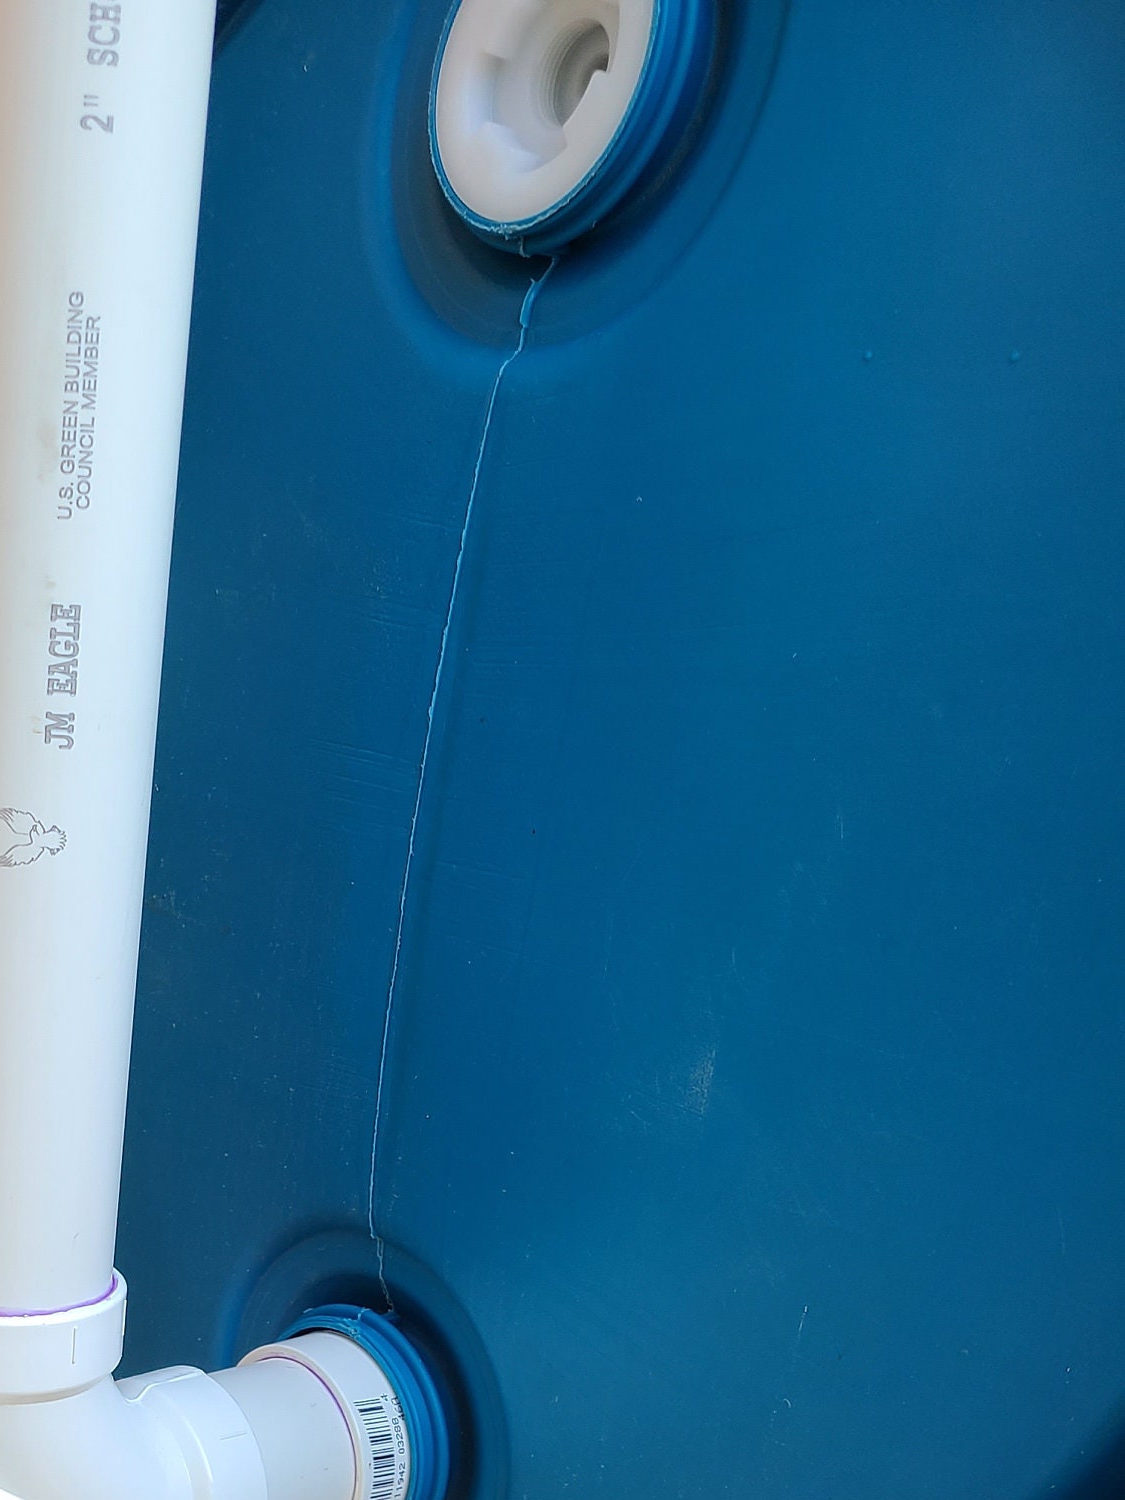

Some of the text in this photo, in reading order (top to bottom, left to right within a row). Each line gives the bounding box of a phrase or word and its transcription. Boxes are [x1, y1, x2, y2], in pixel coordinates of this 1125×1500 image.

[57, 290, 85, 520] U.S. GREEN BUILDING
[76, 315, 101, 510] COUNCIL MEMBER
[44, 603, 82, 750] JM EAGLE
[391, 1417, 406, 1455] 03288
[394, 1461, 406, 1498] 11942
